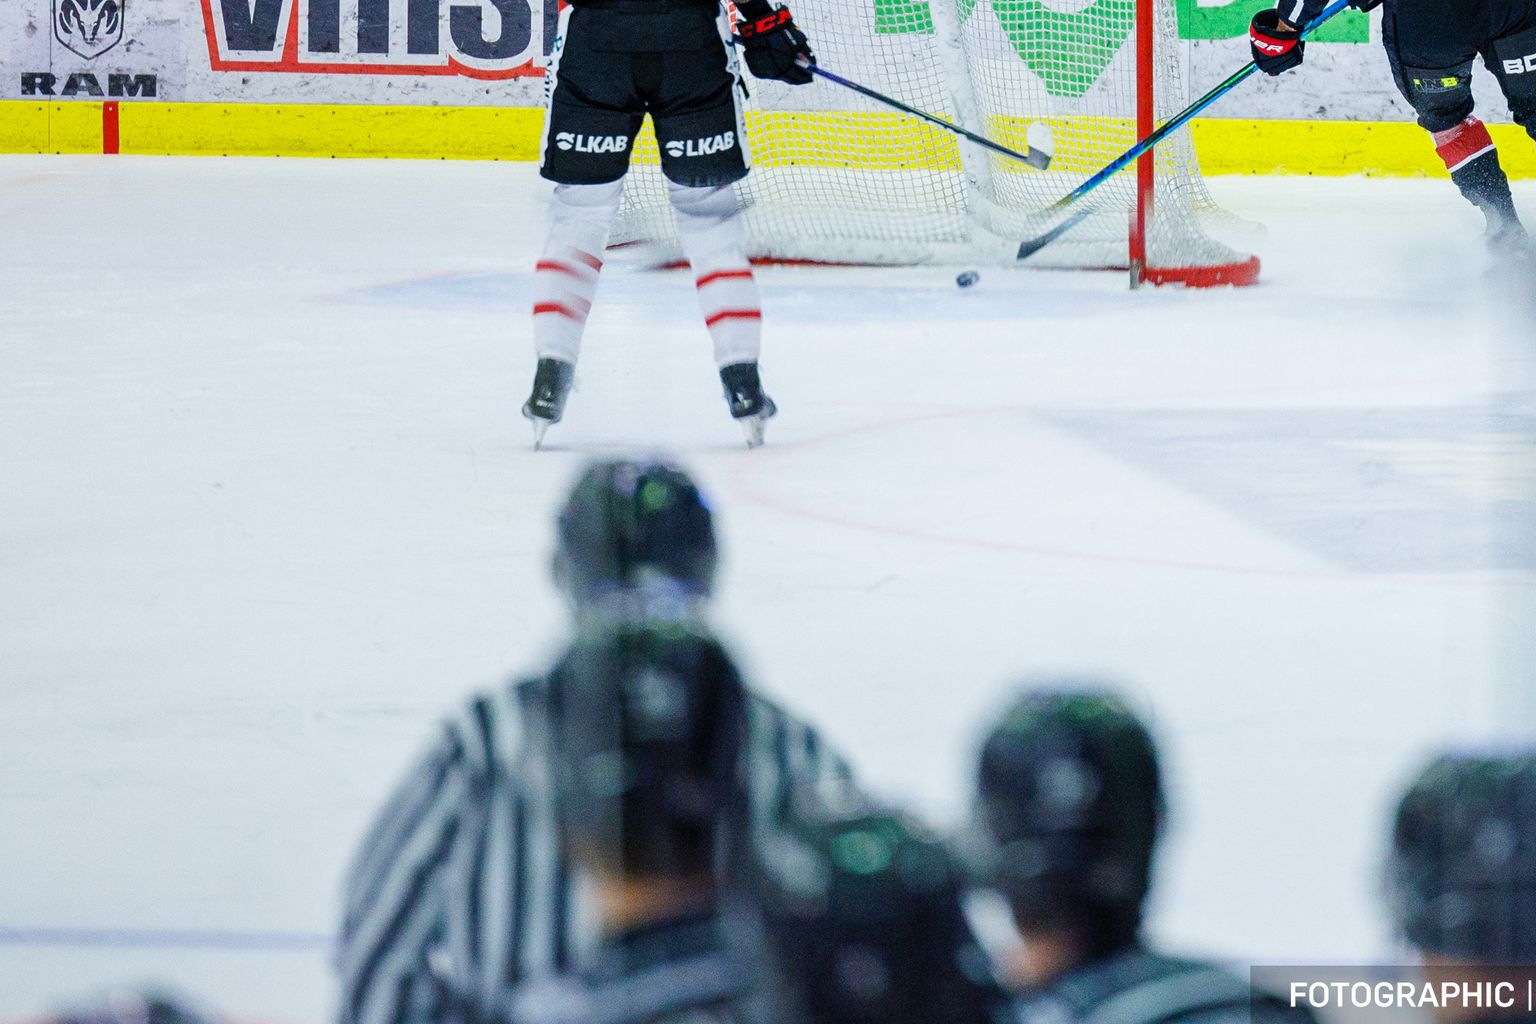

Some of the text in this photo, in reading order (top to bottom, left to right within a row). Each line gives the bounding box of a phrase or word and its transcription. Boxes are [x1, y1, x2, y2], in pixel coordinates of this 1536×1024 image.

[21, 72, 157, 97] RAM
[576, 134, 628, 154] LKAB
[686, 131, 734, 157] LKAB
